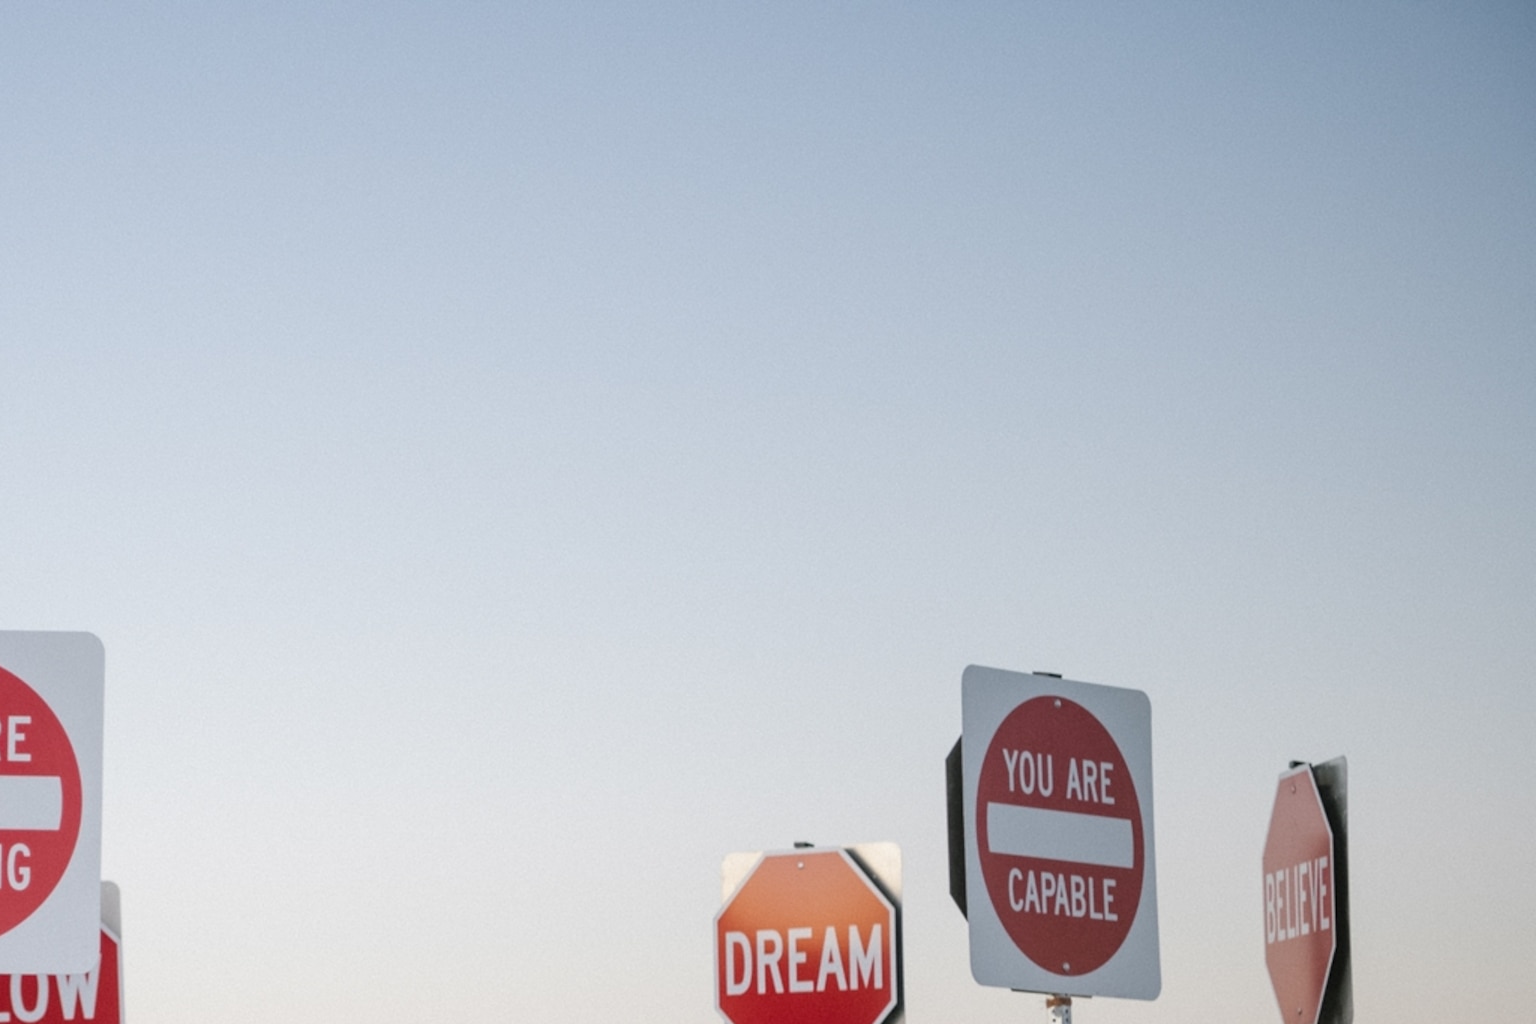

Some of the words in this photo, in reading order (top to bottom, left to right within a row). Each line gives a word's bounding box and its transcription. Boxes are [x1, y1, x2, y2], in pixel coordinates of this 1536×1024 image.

[1002, 748, 1053, 798] YOU
[1066, 757, 1116, 805] ARE
[1008, 867, 1118, 922] CAPABLE
[1265, 856, 1330, 944] BELIEVE
[725, 923, 883, 996] DREAM
